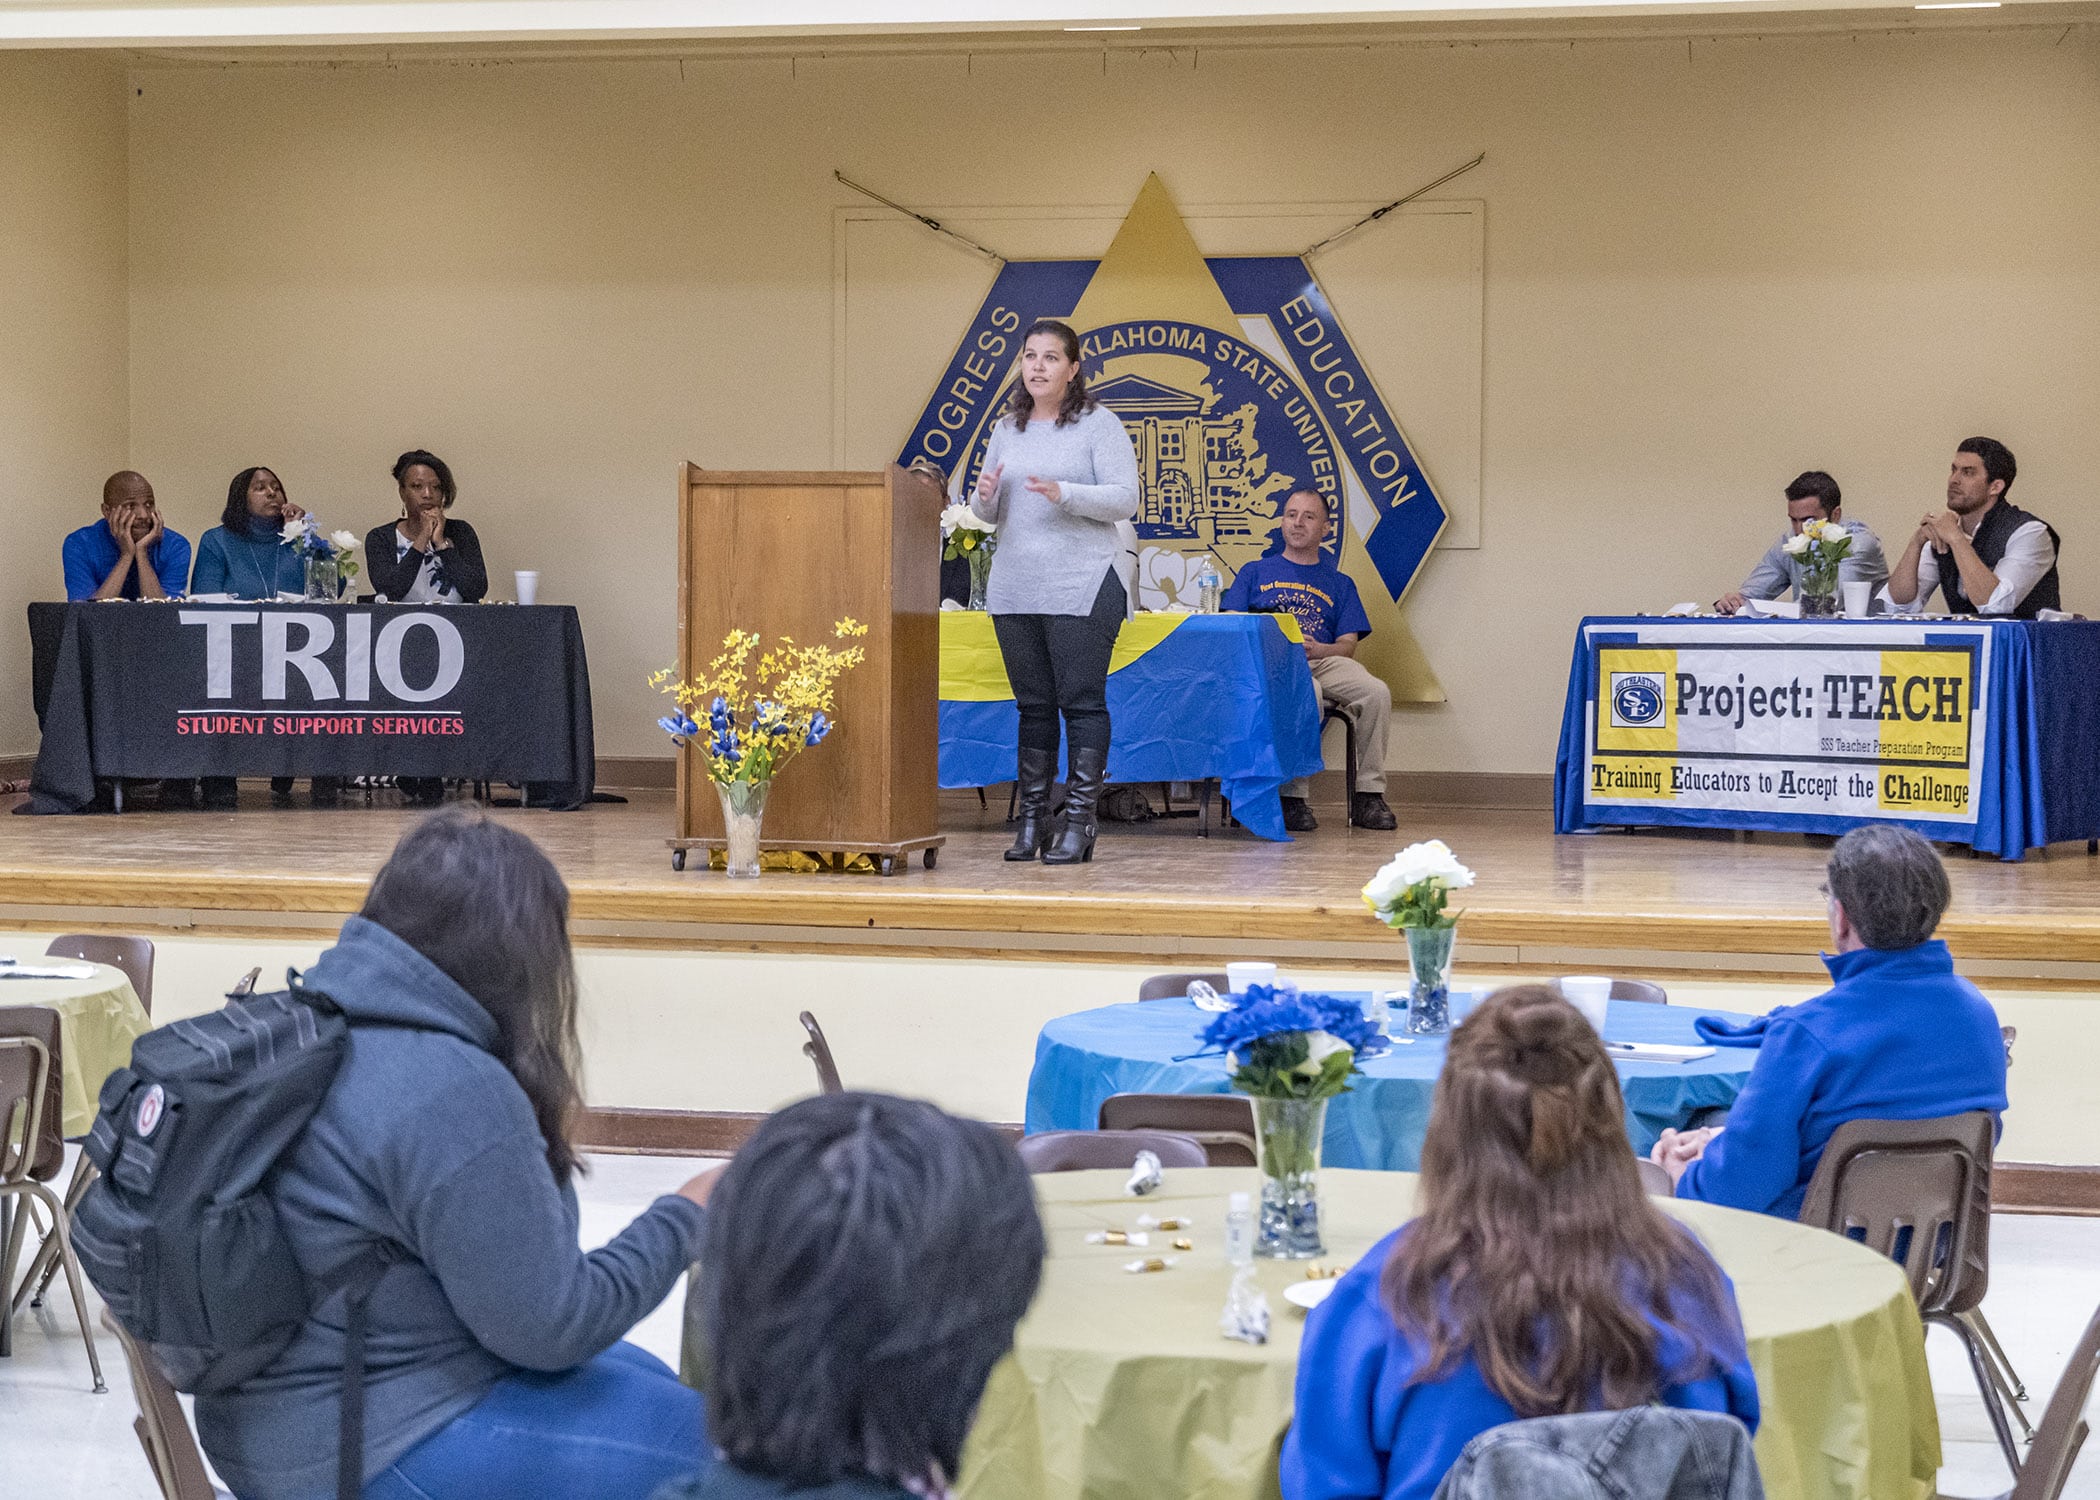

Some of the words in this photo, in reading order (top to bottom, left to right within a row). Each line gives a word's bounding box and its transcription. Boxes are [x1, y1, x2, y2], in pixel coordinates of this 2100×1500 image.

[911, 306, 1020, 466] OGRESS
[1079, 325, 1206, 361] KLAHOMA
[1214, 340, 1289, 400] STATE
[1280, 295, 1418, 508] EDUCATION
[178, 610, 465, 702] TRIO
[176, 717, 267, 735] STUDENT
[273, 717, 366, 735] SUPPORT
[372, 717, 464, 735] SERVICES
[1675, 673, 1813, 729] Project:
[1823, 675, 1963, 722] TEACH
[1820, 737, 1834, 752] SSS
[1836, 738, 1871, 753] Teacher
[1873, 740, 1923, 757] Preparation
[1926, 742, 1963, 759] Program
[1591, 764, 1661, 793] Training
[1670, 766, 1750, 793] Educators
[1759, 772, 1772, 793] to
[1778, 770, 1837, 801] Accept
[1848, 773, 1874, 798] the
[1884, 774, 1969, 808] Challenge
